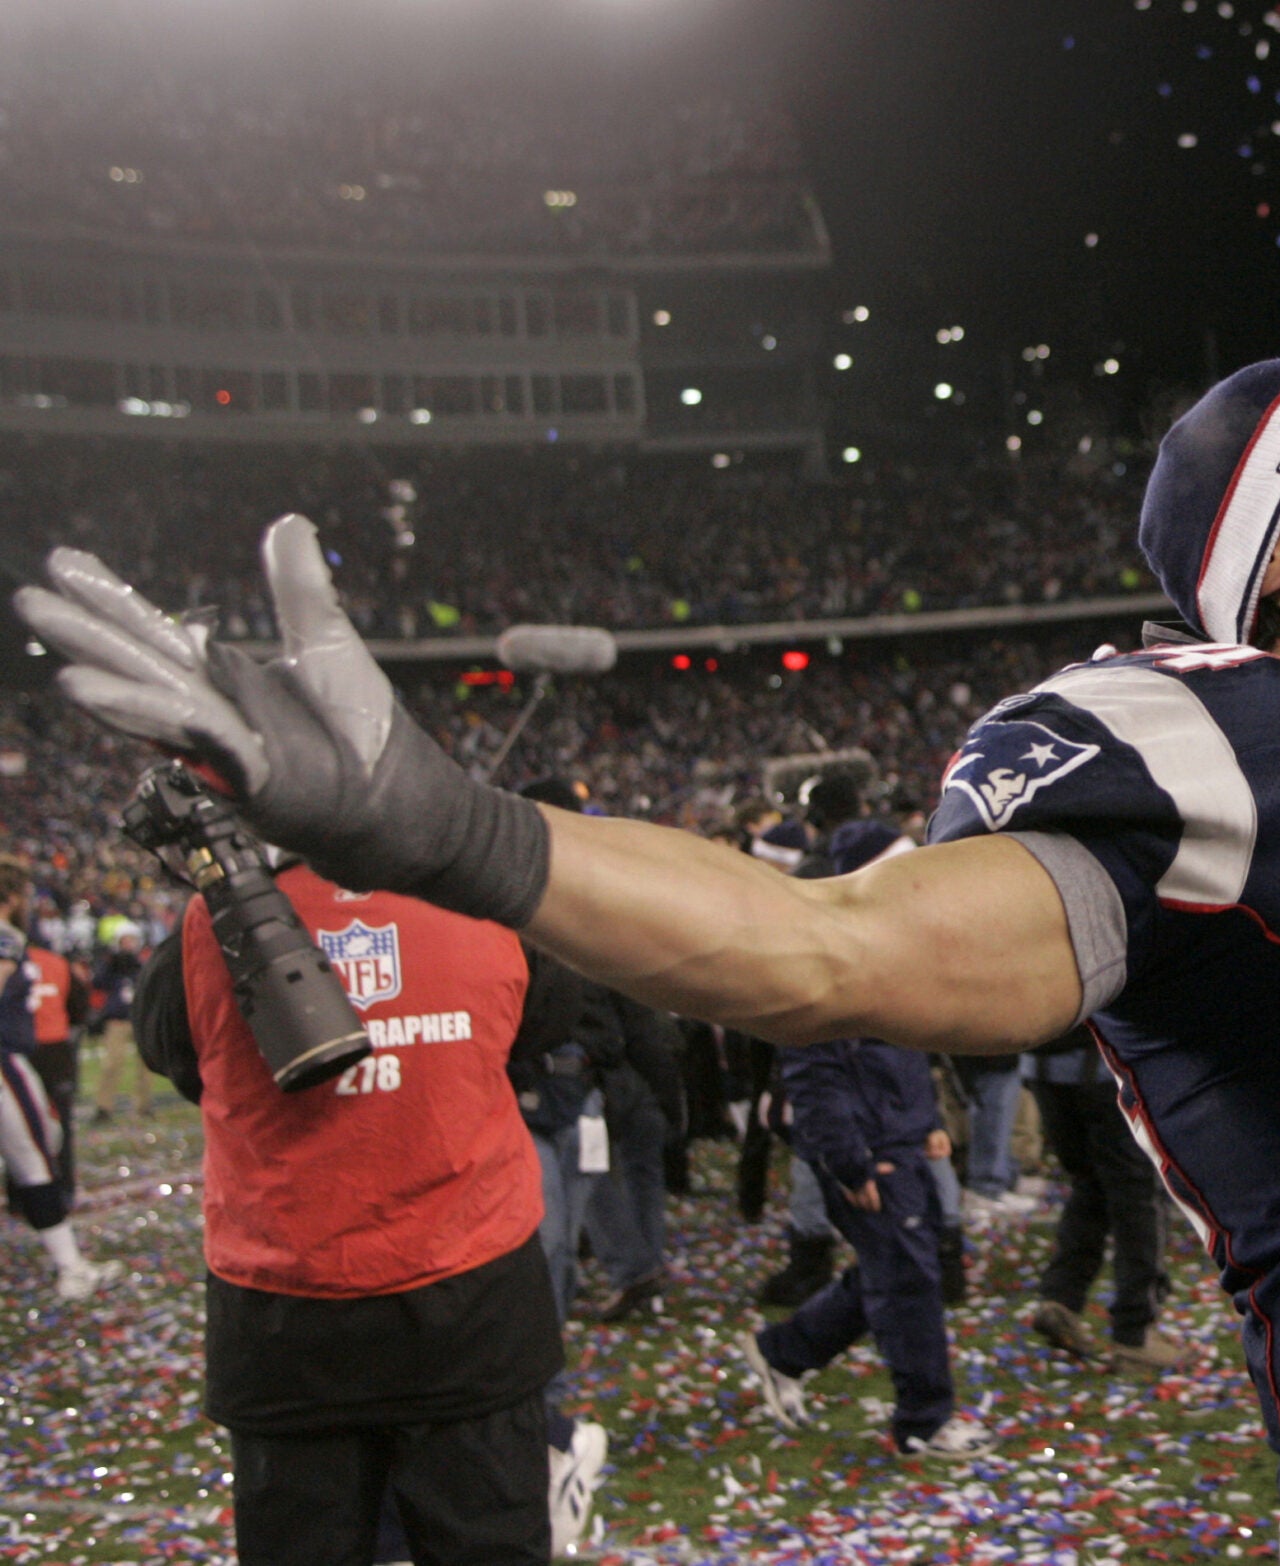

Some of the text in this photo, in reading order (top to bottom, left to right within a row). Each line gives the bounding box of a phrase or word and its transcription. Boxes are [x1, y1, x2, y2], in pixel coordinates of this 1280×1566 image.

[334, 956, 393, 996] NFL
[363, 1011, 471, 1048] RAPHER
[335, 1053, 402, 1095] 278
